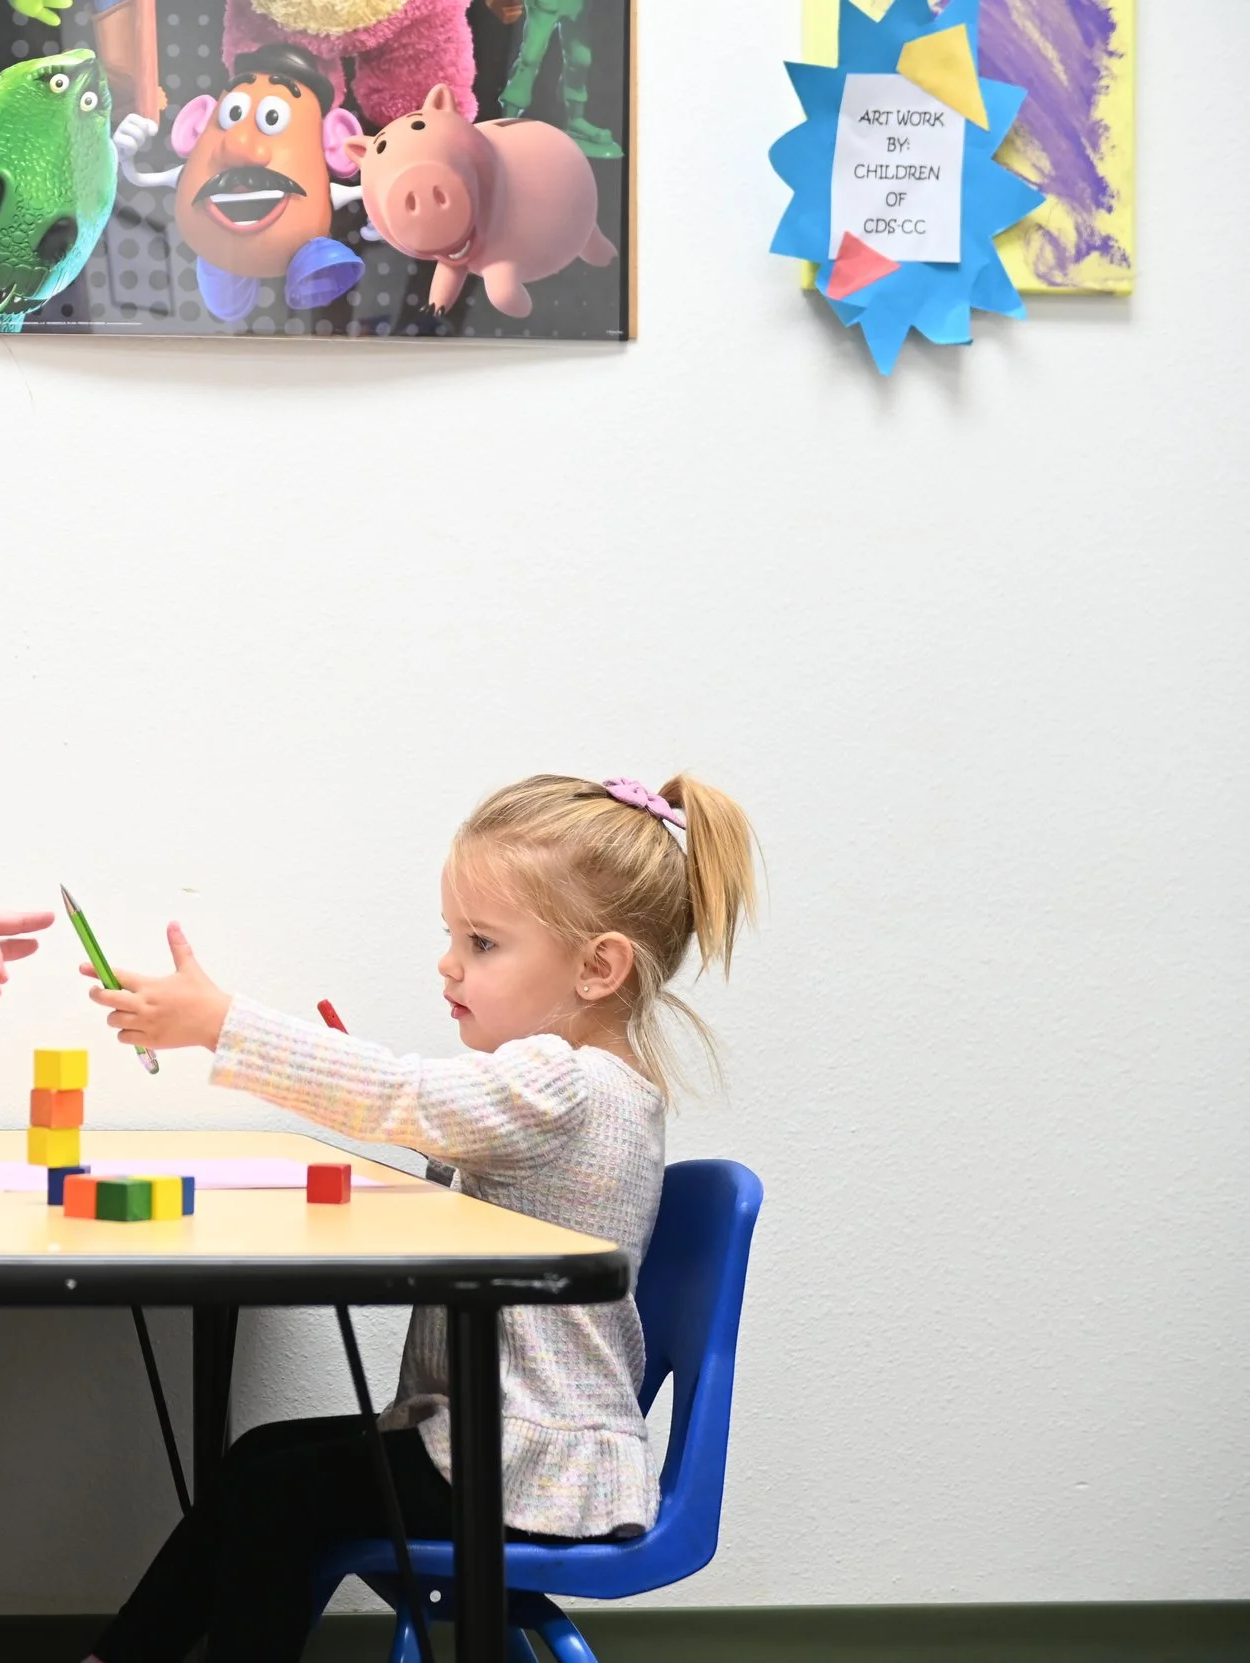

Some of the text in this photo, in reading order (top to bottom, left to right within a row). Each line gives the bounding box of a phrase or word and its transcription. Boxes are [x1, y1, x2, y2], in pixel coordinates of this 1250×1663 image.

[858, 109, 945, 127] ART WORK
[886, 136, 910, 153] BY:
[853, 163, 941, 181] CHILDREN
[885, 191, 908, 207] OF
